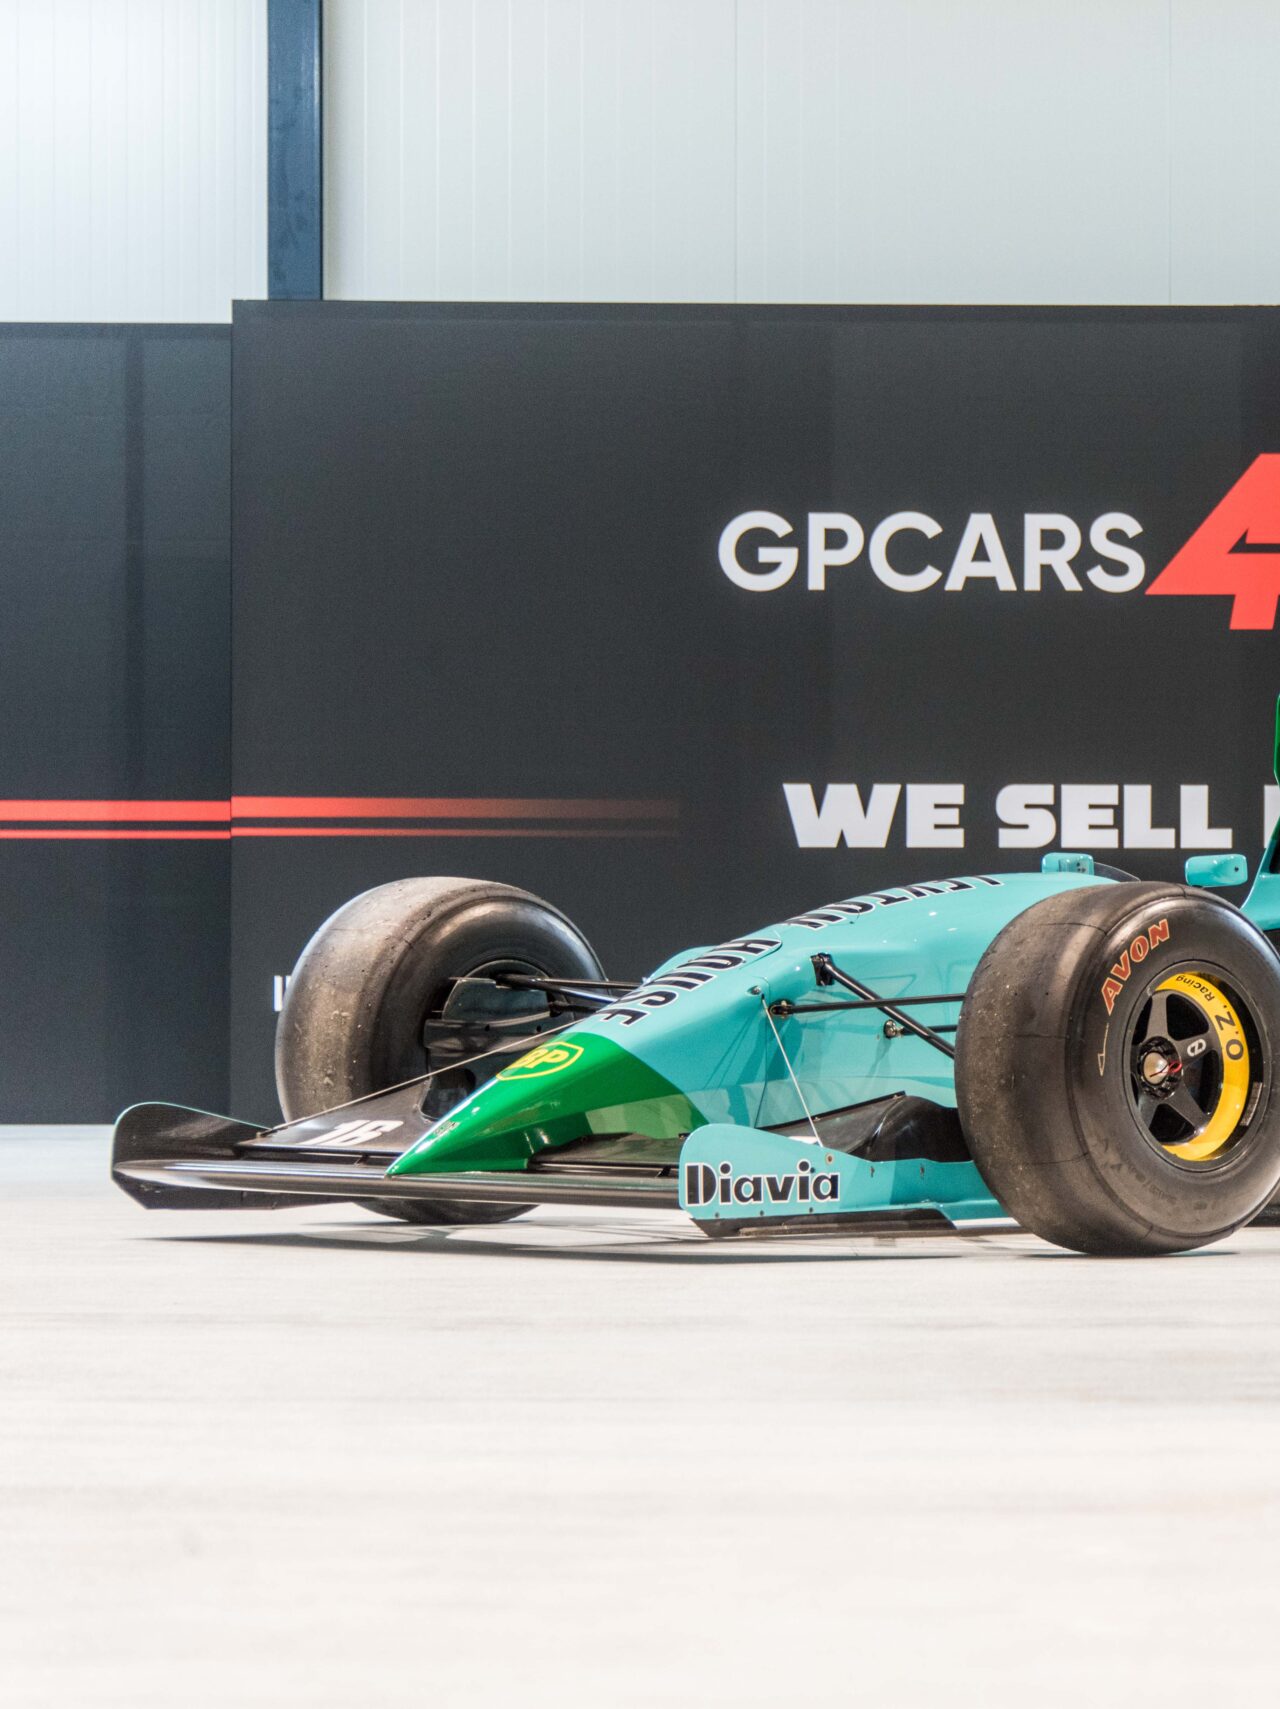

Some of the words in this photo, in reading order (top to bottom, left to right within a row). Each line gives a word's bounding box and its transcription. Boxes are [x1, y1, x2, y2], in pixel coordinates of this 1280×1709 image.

[783, 783, 965, 849] WE
[996, 784, 1233, 849] SELL
[1101, 918, 1171, 1017] AVON
[1175, 974, 1216, 1003] Racing
[508, 1048, 570, 1069] BP
[684, 1158, 841, 1207] Diavia
